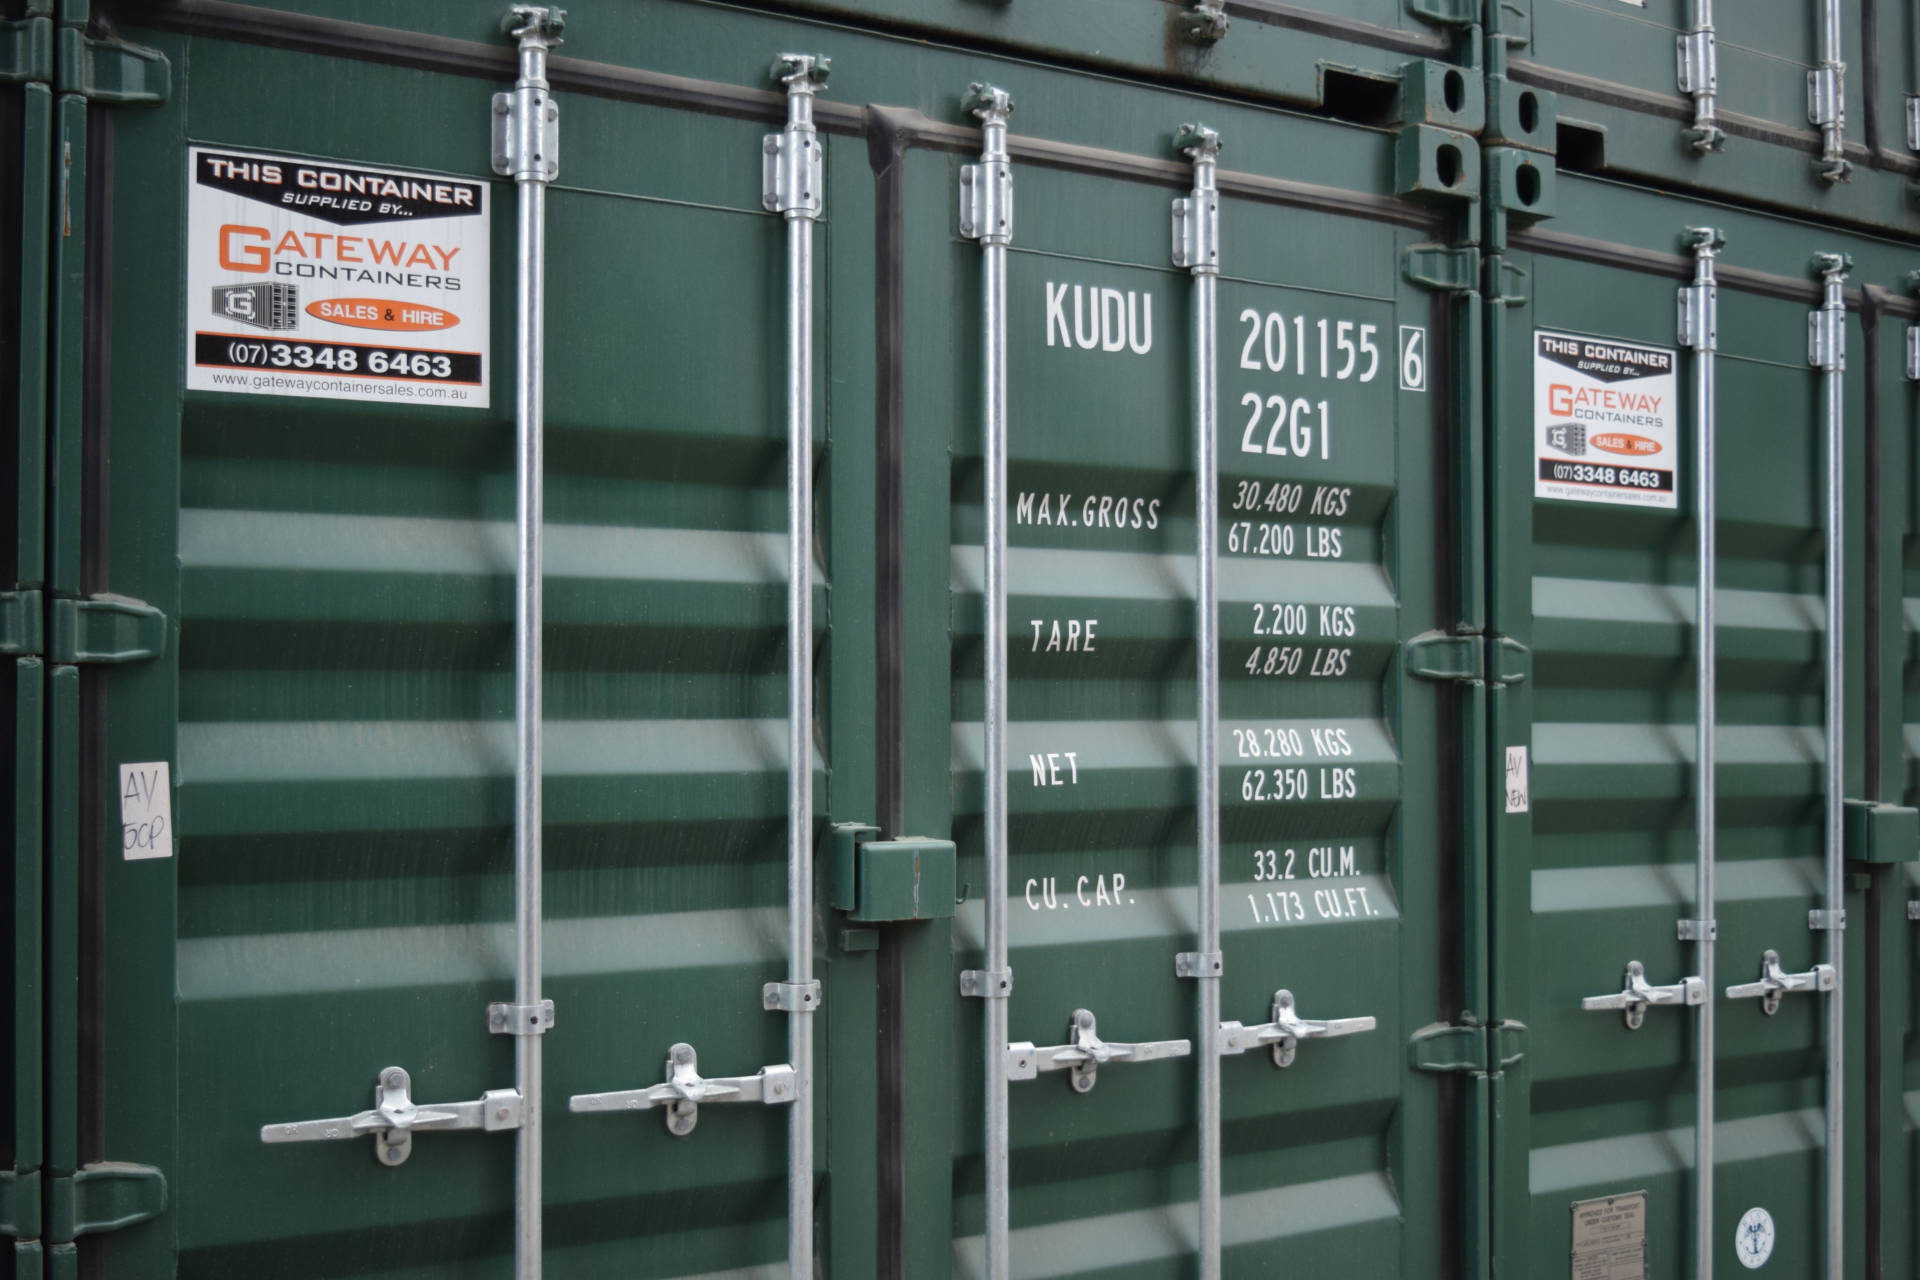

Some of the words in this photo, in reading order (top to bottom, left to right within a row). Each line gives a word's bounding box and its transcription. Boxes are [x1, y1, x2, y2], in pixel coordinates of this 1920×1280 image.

[206, 157, 284, 185] THIS
[297, 168, 474, 207] CONTAINER
[281, 192, 371, 212] SUPPLIED
[219, 223, 462, 274] GATEWAY
[275, 261, 462, 291] CONTAINERS
[320, 302, 379, 321] SALES
[384, 308, 395, 322] &
[402, 310, 444, 326] HIRE
[1045, 281, 1152, 355] KUDU
[1240, 309, 1379, 383] 201155
[1403, 332, 1423, 387] 6
[368, 352, 452, 378] 6463
[1542, 338, 1579, 355] THIS
[1584, 344, 1669, 368] CONTAINER
[1577, 360, 1620, 374] SUPPLIED
[212, 372, 468, 400] www.gatewaycontainersales.com.au
[1549, 383, 1663, 417] GATEWAY
[1241, 392, 1329, 460] 22G1
[1574, 408, 1664, 428] CONTAINERS
[1596, 436, 1625, 449] SALES
[1634, 441, 1655, 451] HIRE
[1619, 470, 1660, 488] 6463
[1310, 486, 1351, 516] KGS
[1306, 526, 1342, 558] LBS
[1031, 620, 1098, 652] TARE
[1320, 605, 1355, 637] KGS
[1310, 647, 1351, 676] LBS
[1030, 752, 1077, 786] NET
[1311, 728, 1352, 757] KGS
[1320, 767, 1356, 799] LBS
[1254, 849, 1295, 881] 33.2
[1248, 891, 1305, 924] 1.173
